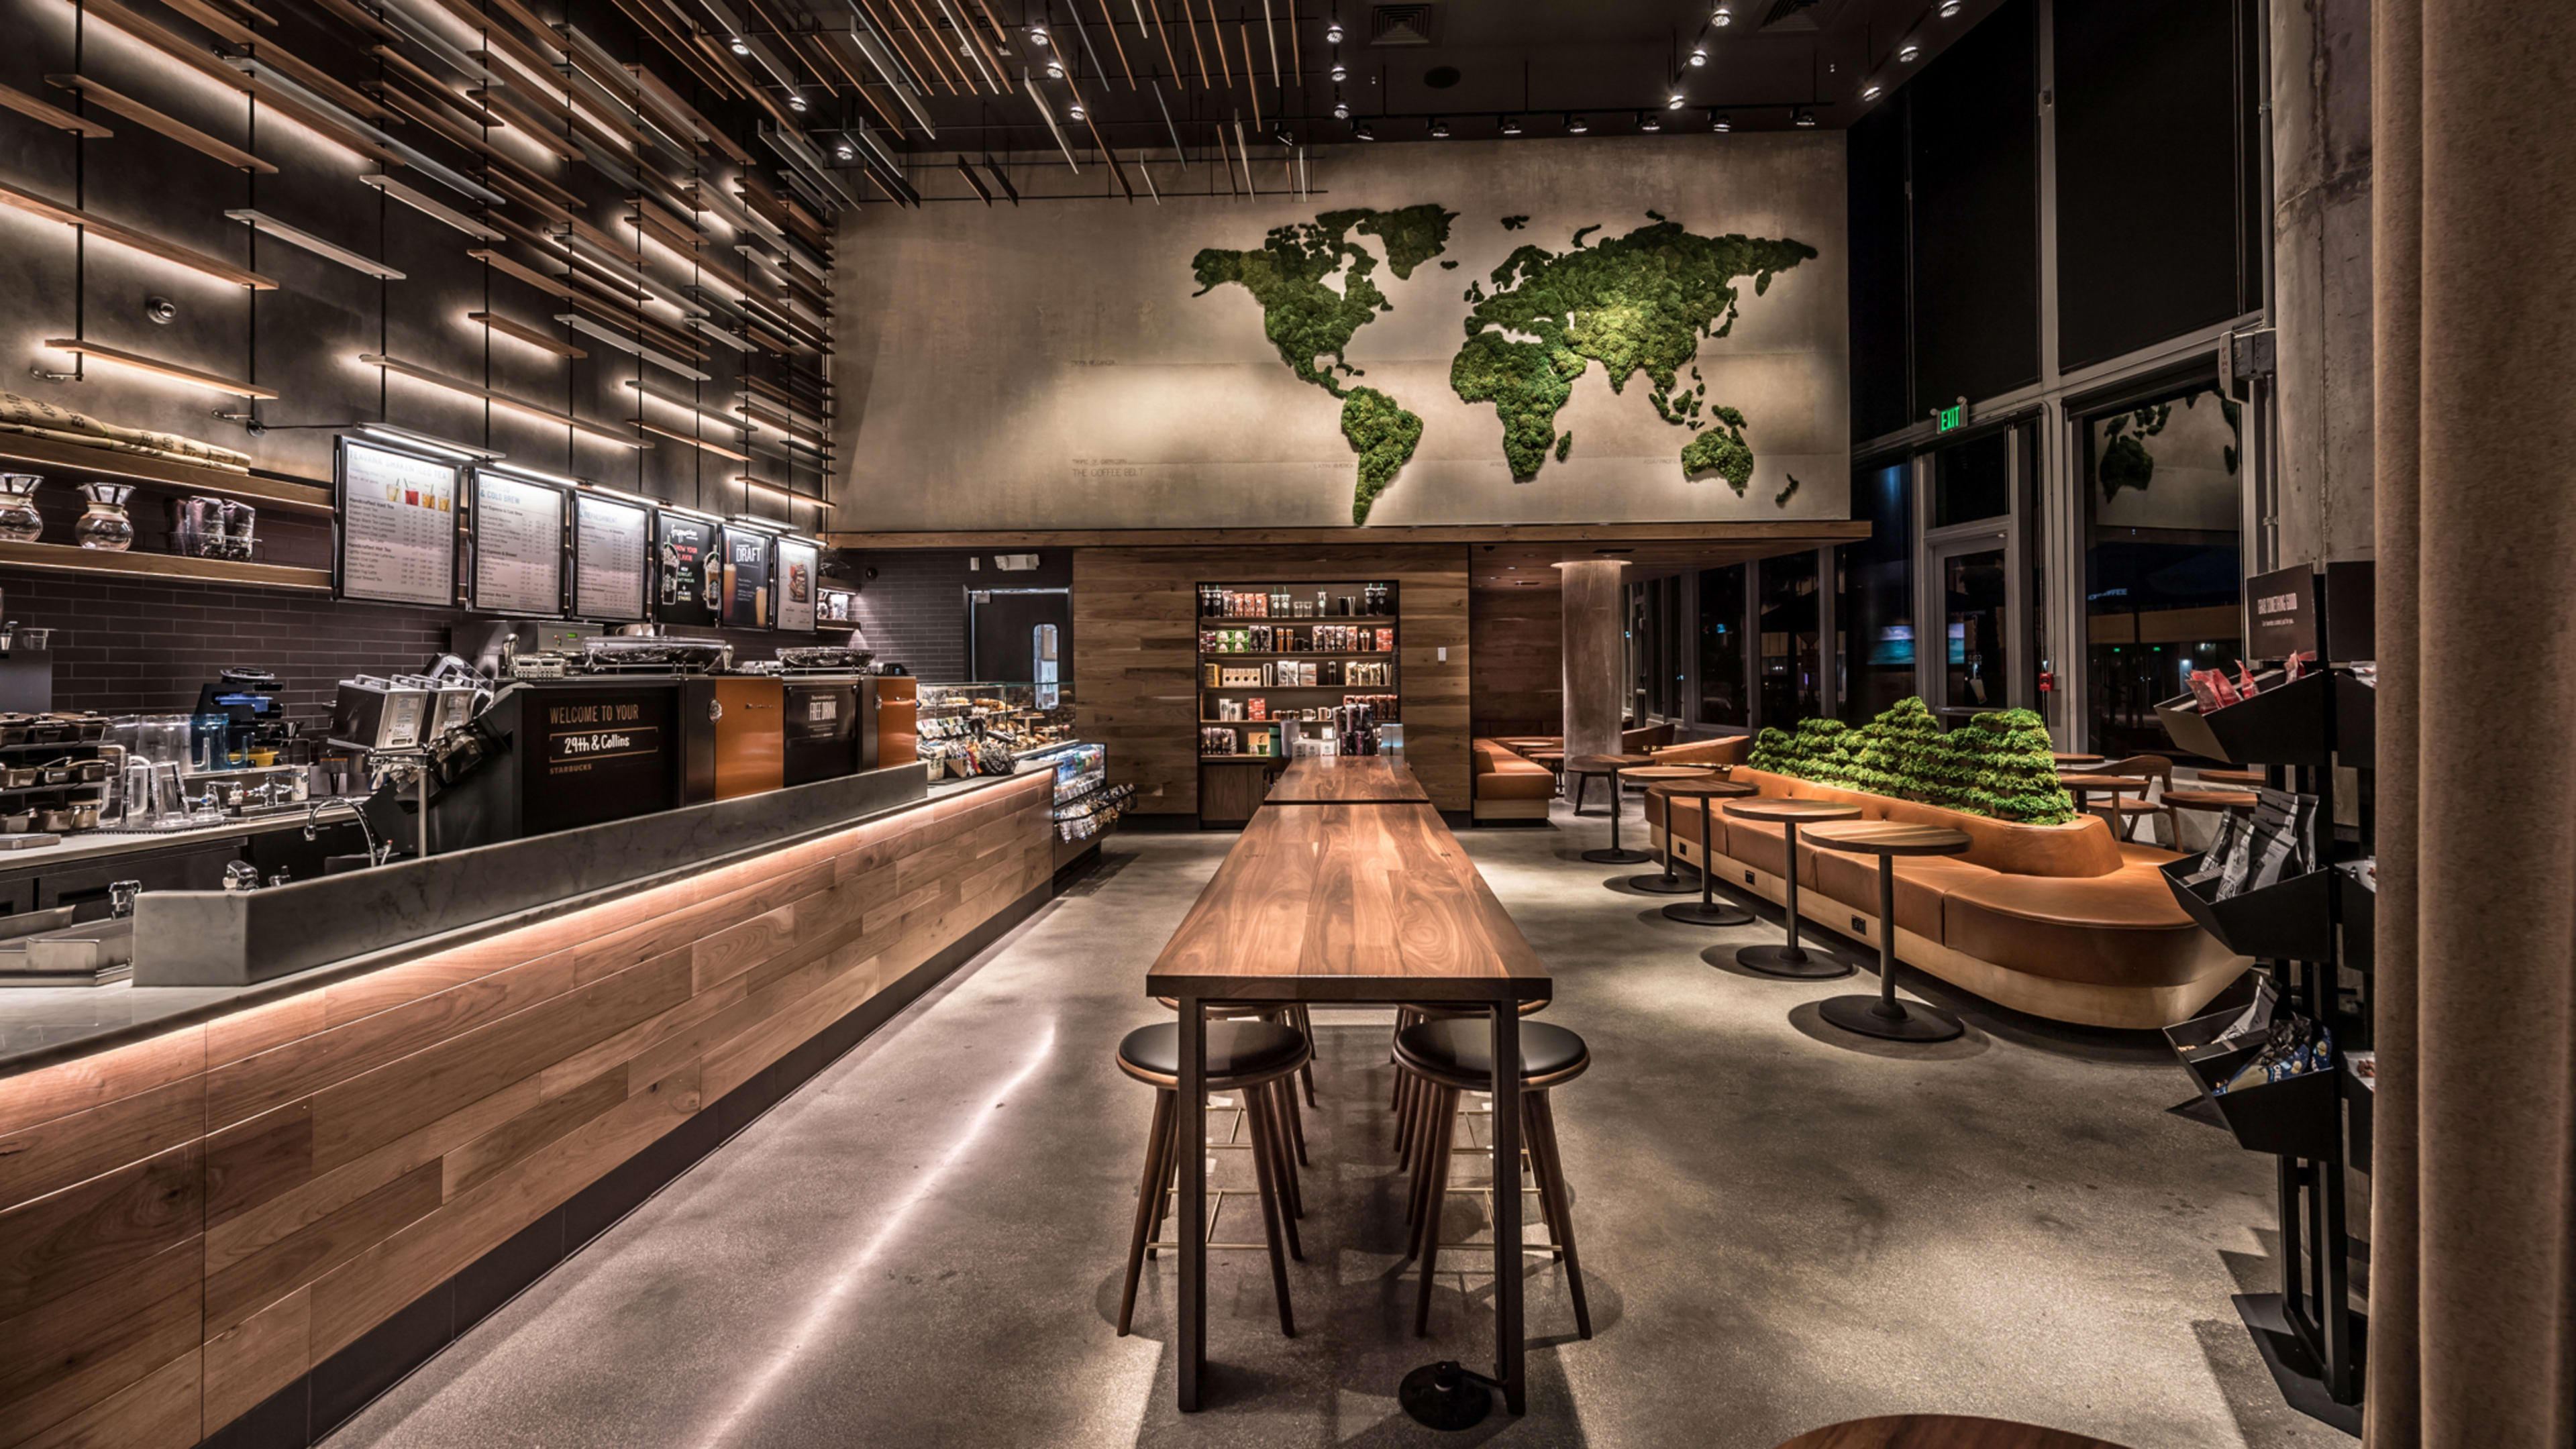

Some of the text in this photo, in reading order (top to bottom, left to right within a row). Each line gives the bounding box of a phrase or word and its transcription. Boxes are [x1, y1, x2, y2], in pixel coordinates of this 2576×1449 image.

[1941, 405, 1960, 431] EXIT
[1072, 468, 1145, 478] THE COFFEE BELT
[736, 547, 762, 563] DRAFT
[550, 704, 639, 724] WELCOME TO YOUR
[809, 700, 837, 721] FREE DRINK
[564, 733, 631, 755] 29th & Collins
[549, 763, 593, 775] STARBUCKS
